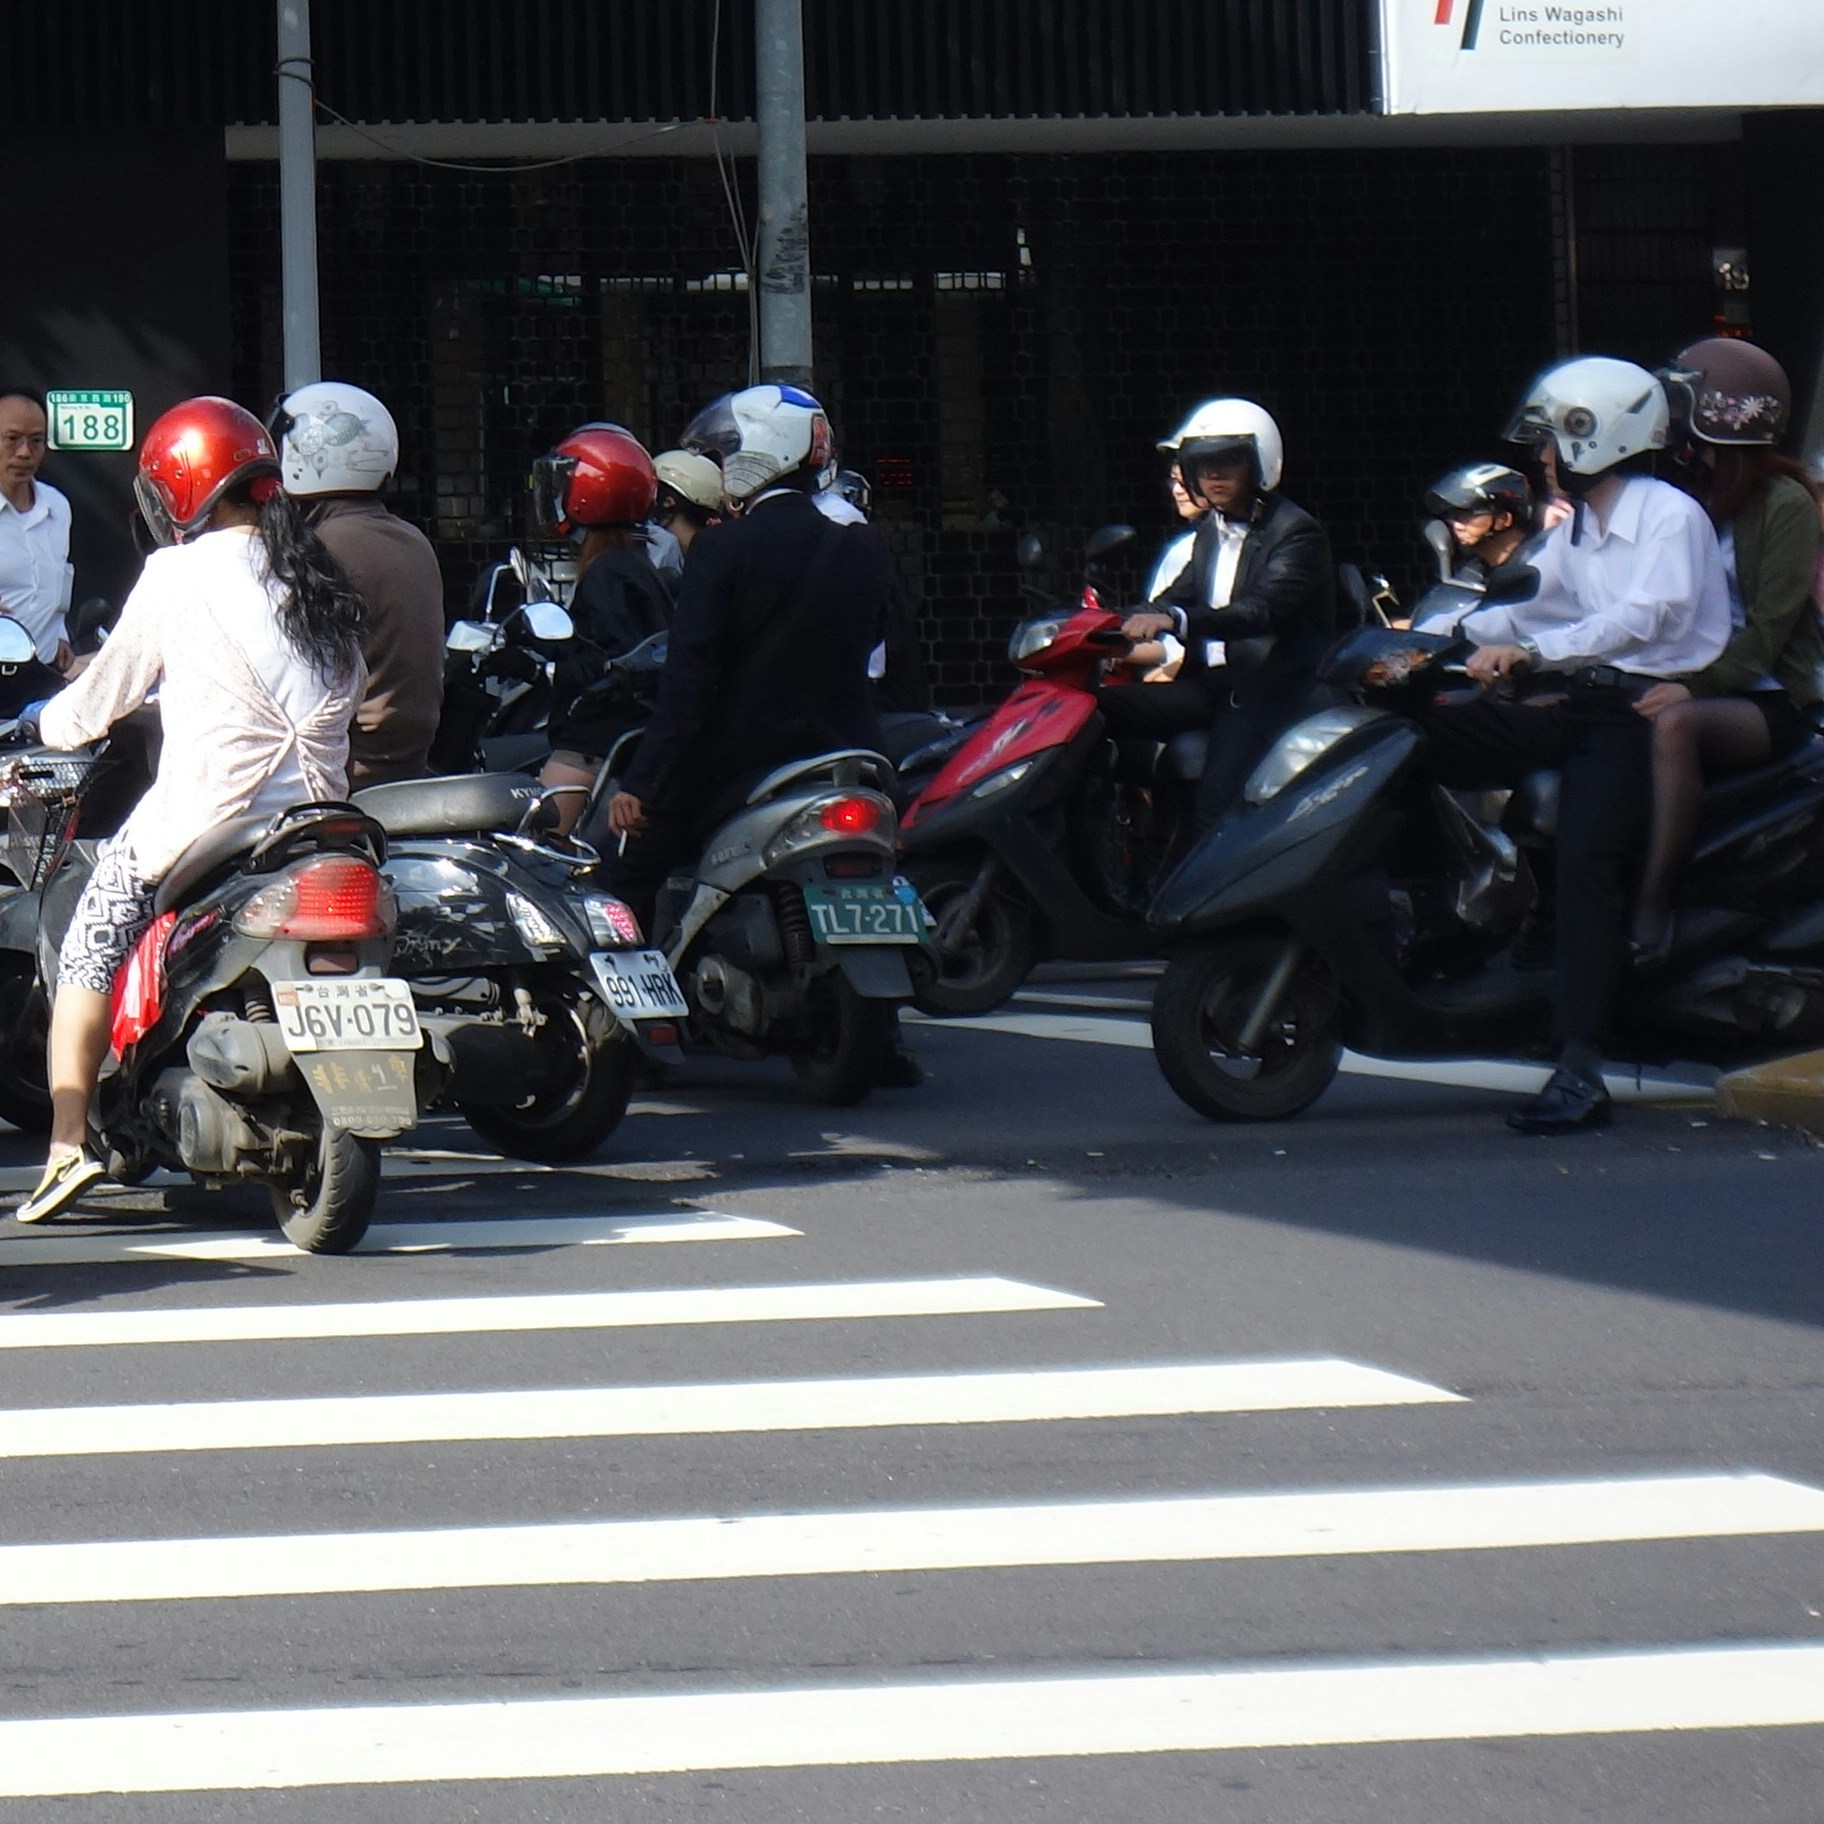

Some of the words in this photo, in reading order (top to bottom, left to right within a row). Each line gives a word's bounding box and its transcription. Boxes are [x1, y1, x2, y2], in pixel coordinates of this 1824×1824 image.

[1499, 7, 1538, 22] Lins
[1545, 7, 1624, 27] Wagashi
[1499, 29, 1625, 49] Confectionery
[50, 394, 68, 403] 186
[63, 414, 120, 441] 188
[811, 904, 920, 934] TL7-271
[606, 972, 684, 1008] 991-HRK
[287, 1002, 417, 1038] J6V-079
